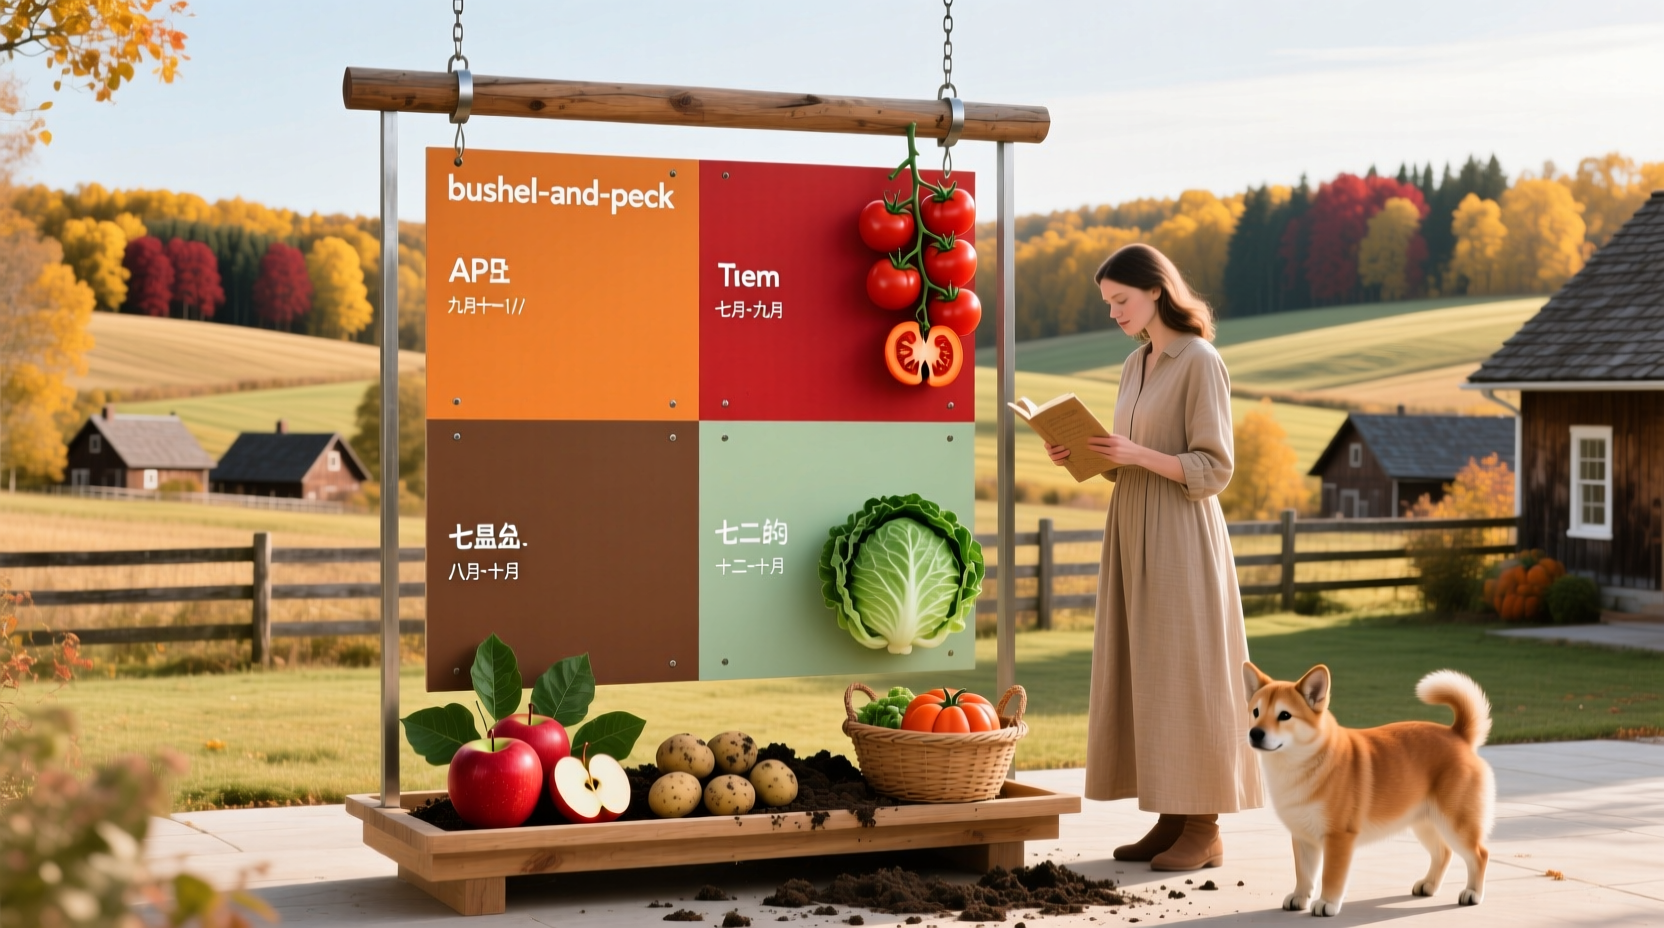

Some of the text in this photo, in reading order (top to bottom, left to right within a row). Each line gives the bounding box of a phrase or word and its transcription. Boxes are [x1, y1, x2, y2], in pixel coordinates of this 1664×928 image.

[448, 173, 675, 215] bushel-and-peck
[714, 300, 783, 319] 七月-九月
[448, 561, 519, 581] 八月-十月
